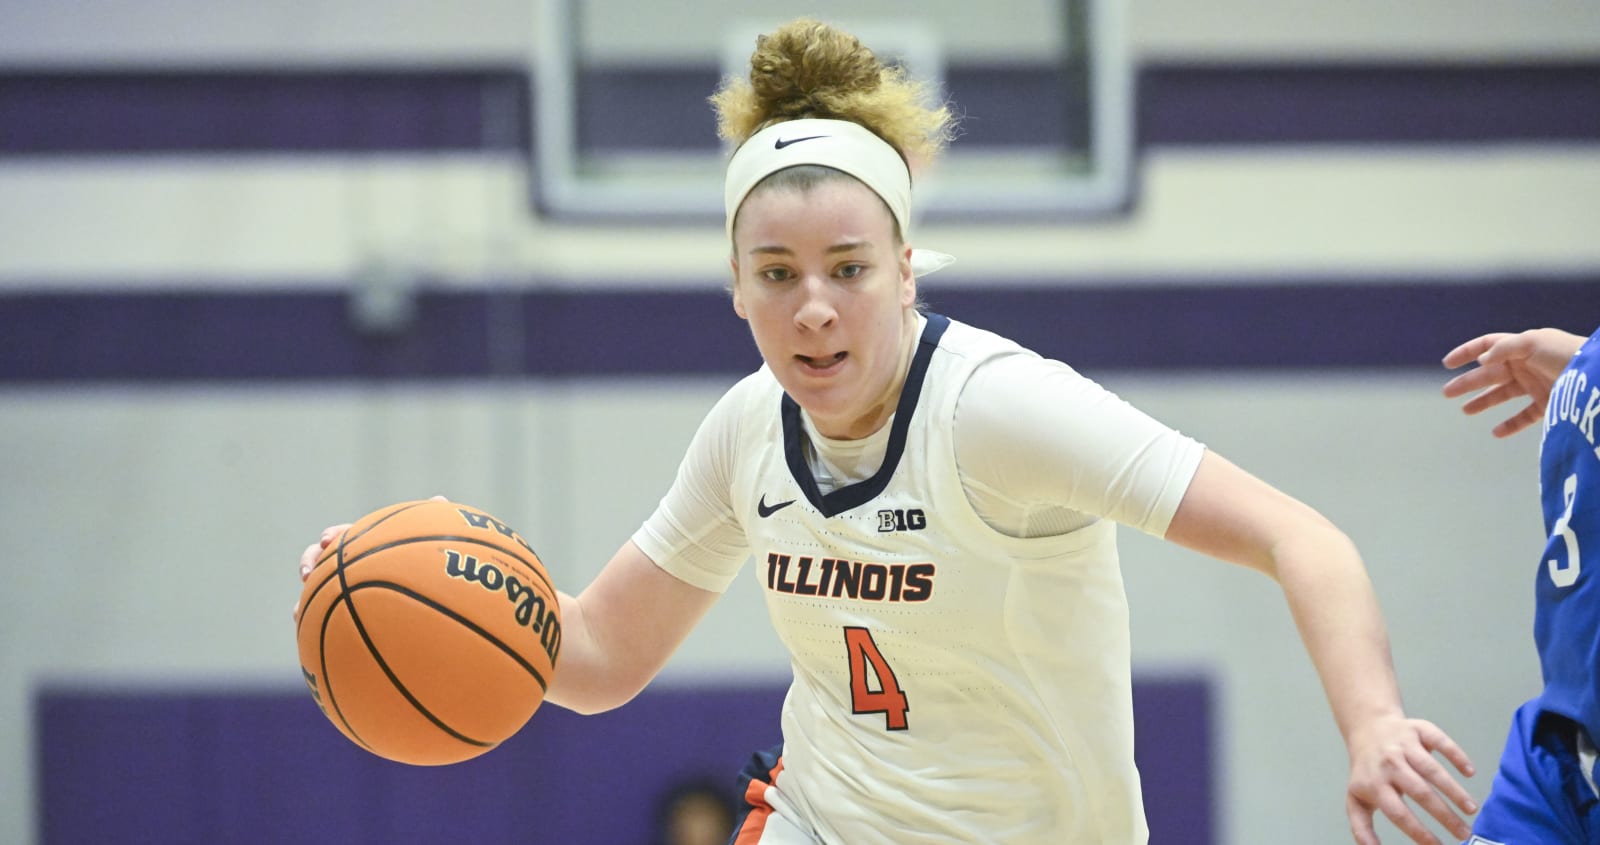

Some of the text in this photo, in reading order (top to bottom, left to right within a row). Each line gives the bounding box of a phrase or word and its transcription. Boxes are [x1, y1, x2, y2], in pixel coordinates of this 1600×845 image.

[767, 552, 936, 602] ILLINOIS
[1548, 473, 1580, 587] 3
[445, 549, 562, 671] Wilson
[843, 626, 910, 731] 4
